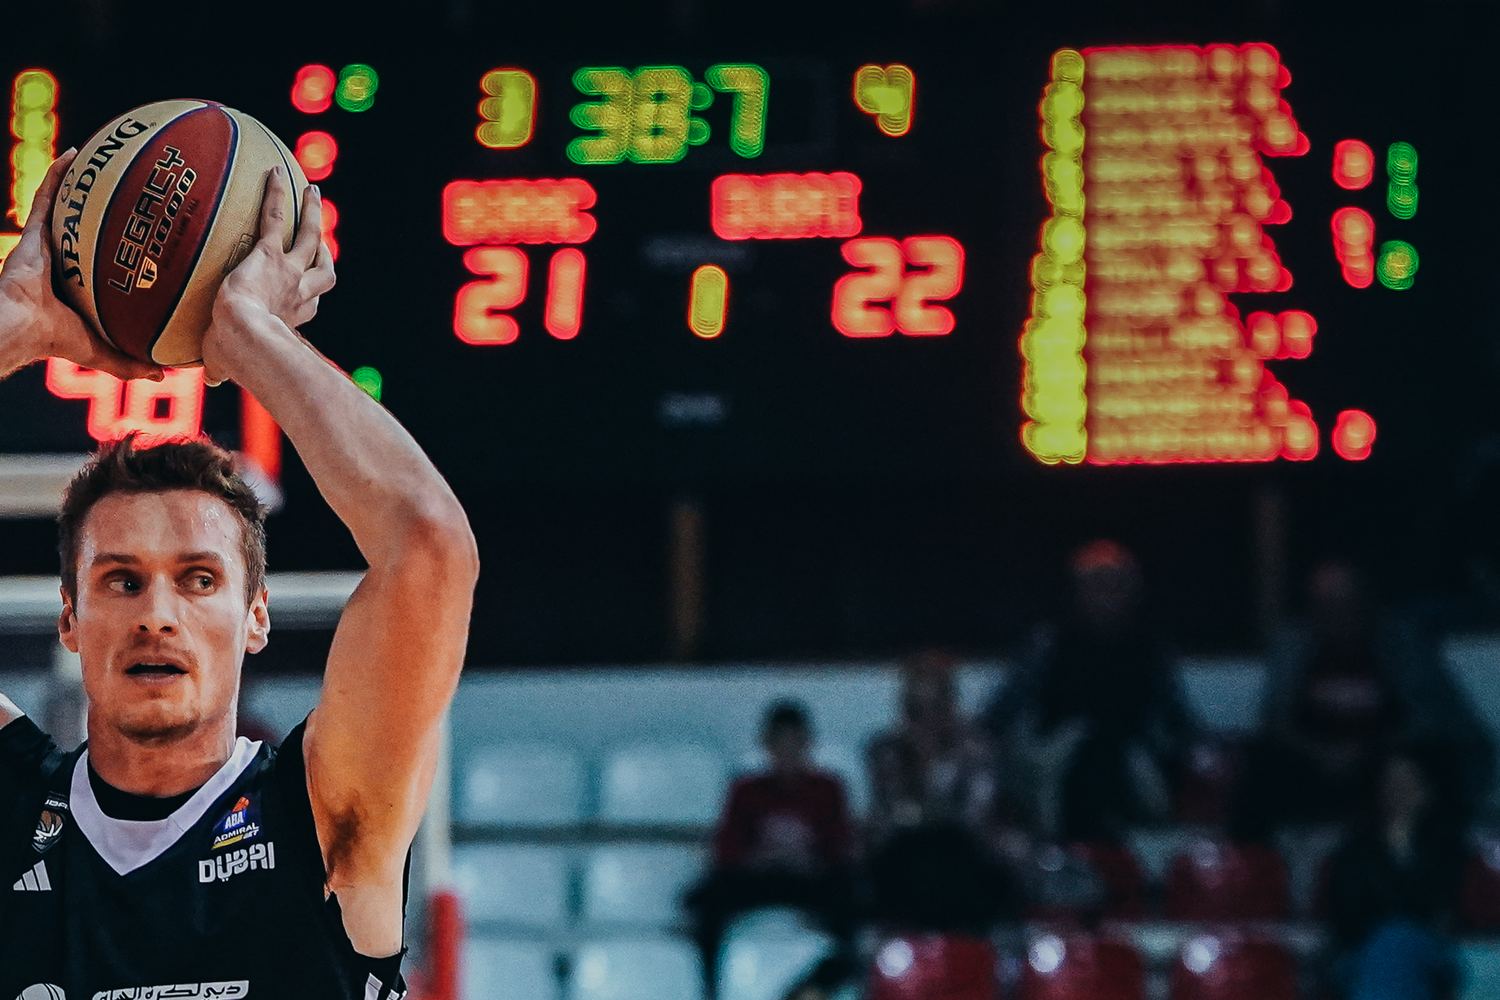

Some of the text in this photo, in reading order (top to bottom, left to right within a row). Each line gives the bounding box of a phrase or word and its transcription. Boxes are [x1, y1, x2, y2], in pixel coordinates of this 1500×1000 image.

[60, 117, 149, 288] SPALDING
[107, 145, 184, 295] LEGACY
[148, 167, 197, 258] 1000
[453, 246, 586, 345] 21
[832, 235, 964, 338] 22
[198, 842, 276, 883] DUBAI
[213, 822, 260, 845] ADMIRAL
